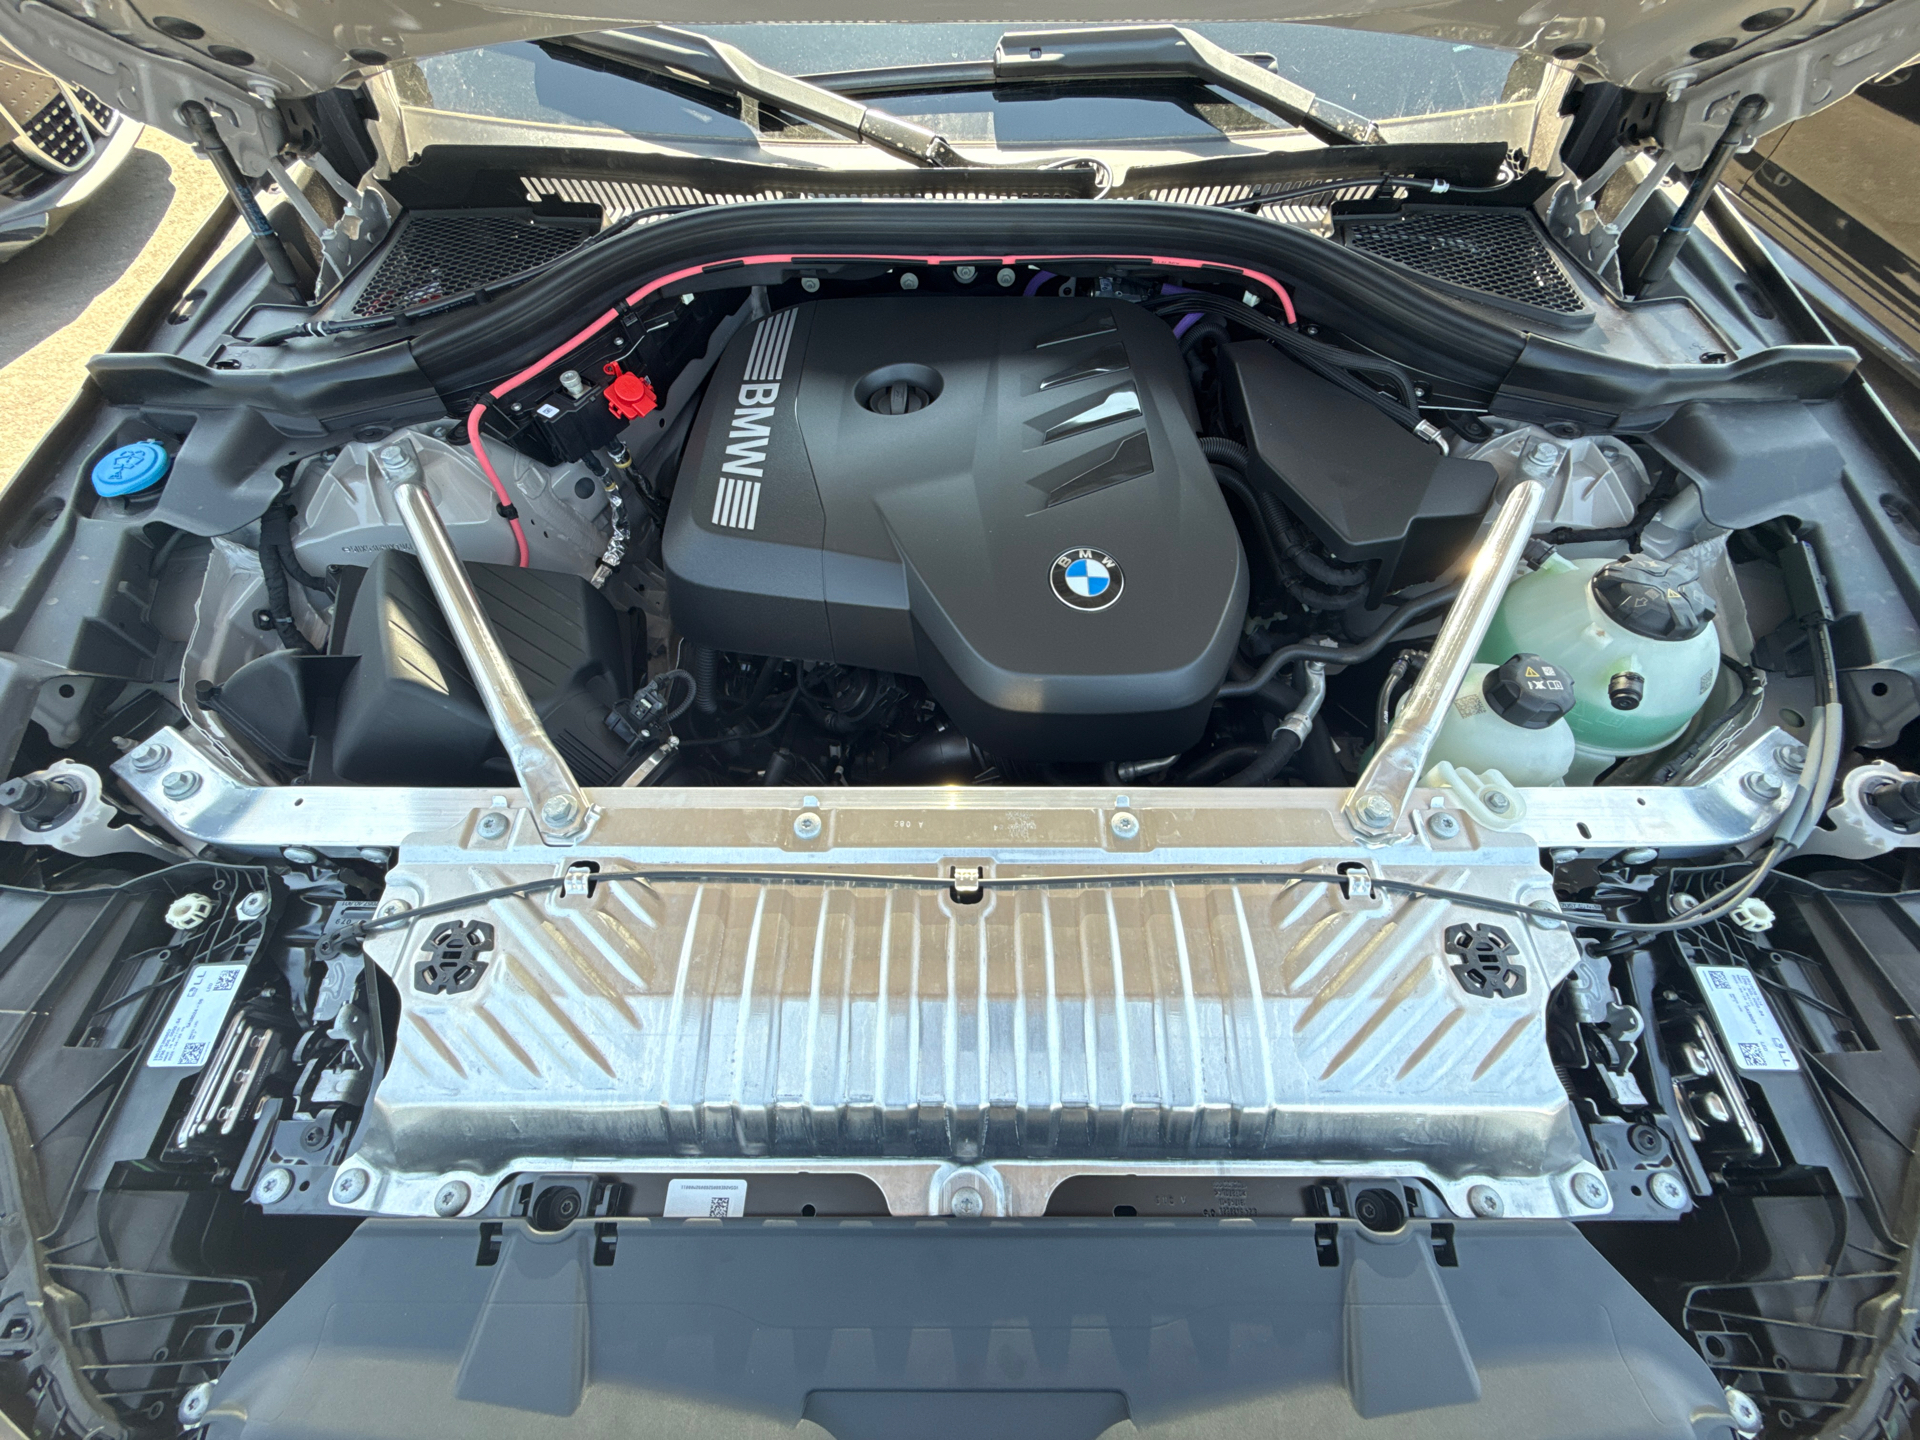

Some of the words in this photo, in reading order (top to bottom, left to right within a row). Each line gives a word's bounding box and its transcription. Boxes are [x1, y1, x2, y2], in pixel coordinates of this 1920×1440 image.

[721, 382, 780, 478] BMW
[1057, 549, 1116, 568] BMW
[917, 820, 924, 829] A
